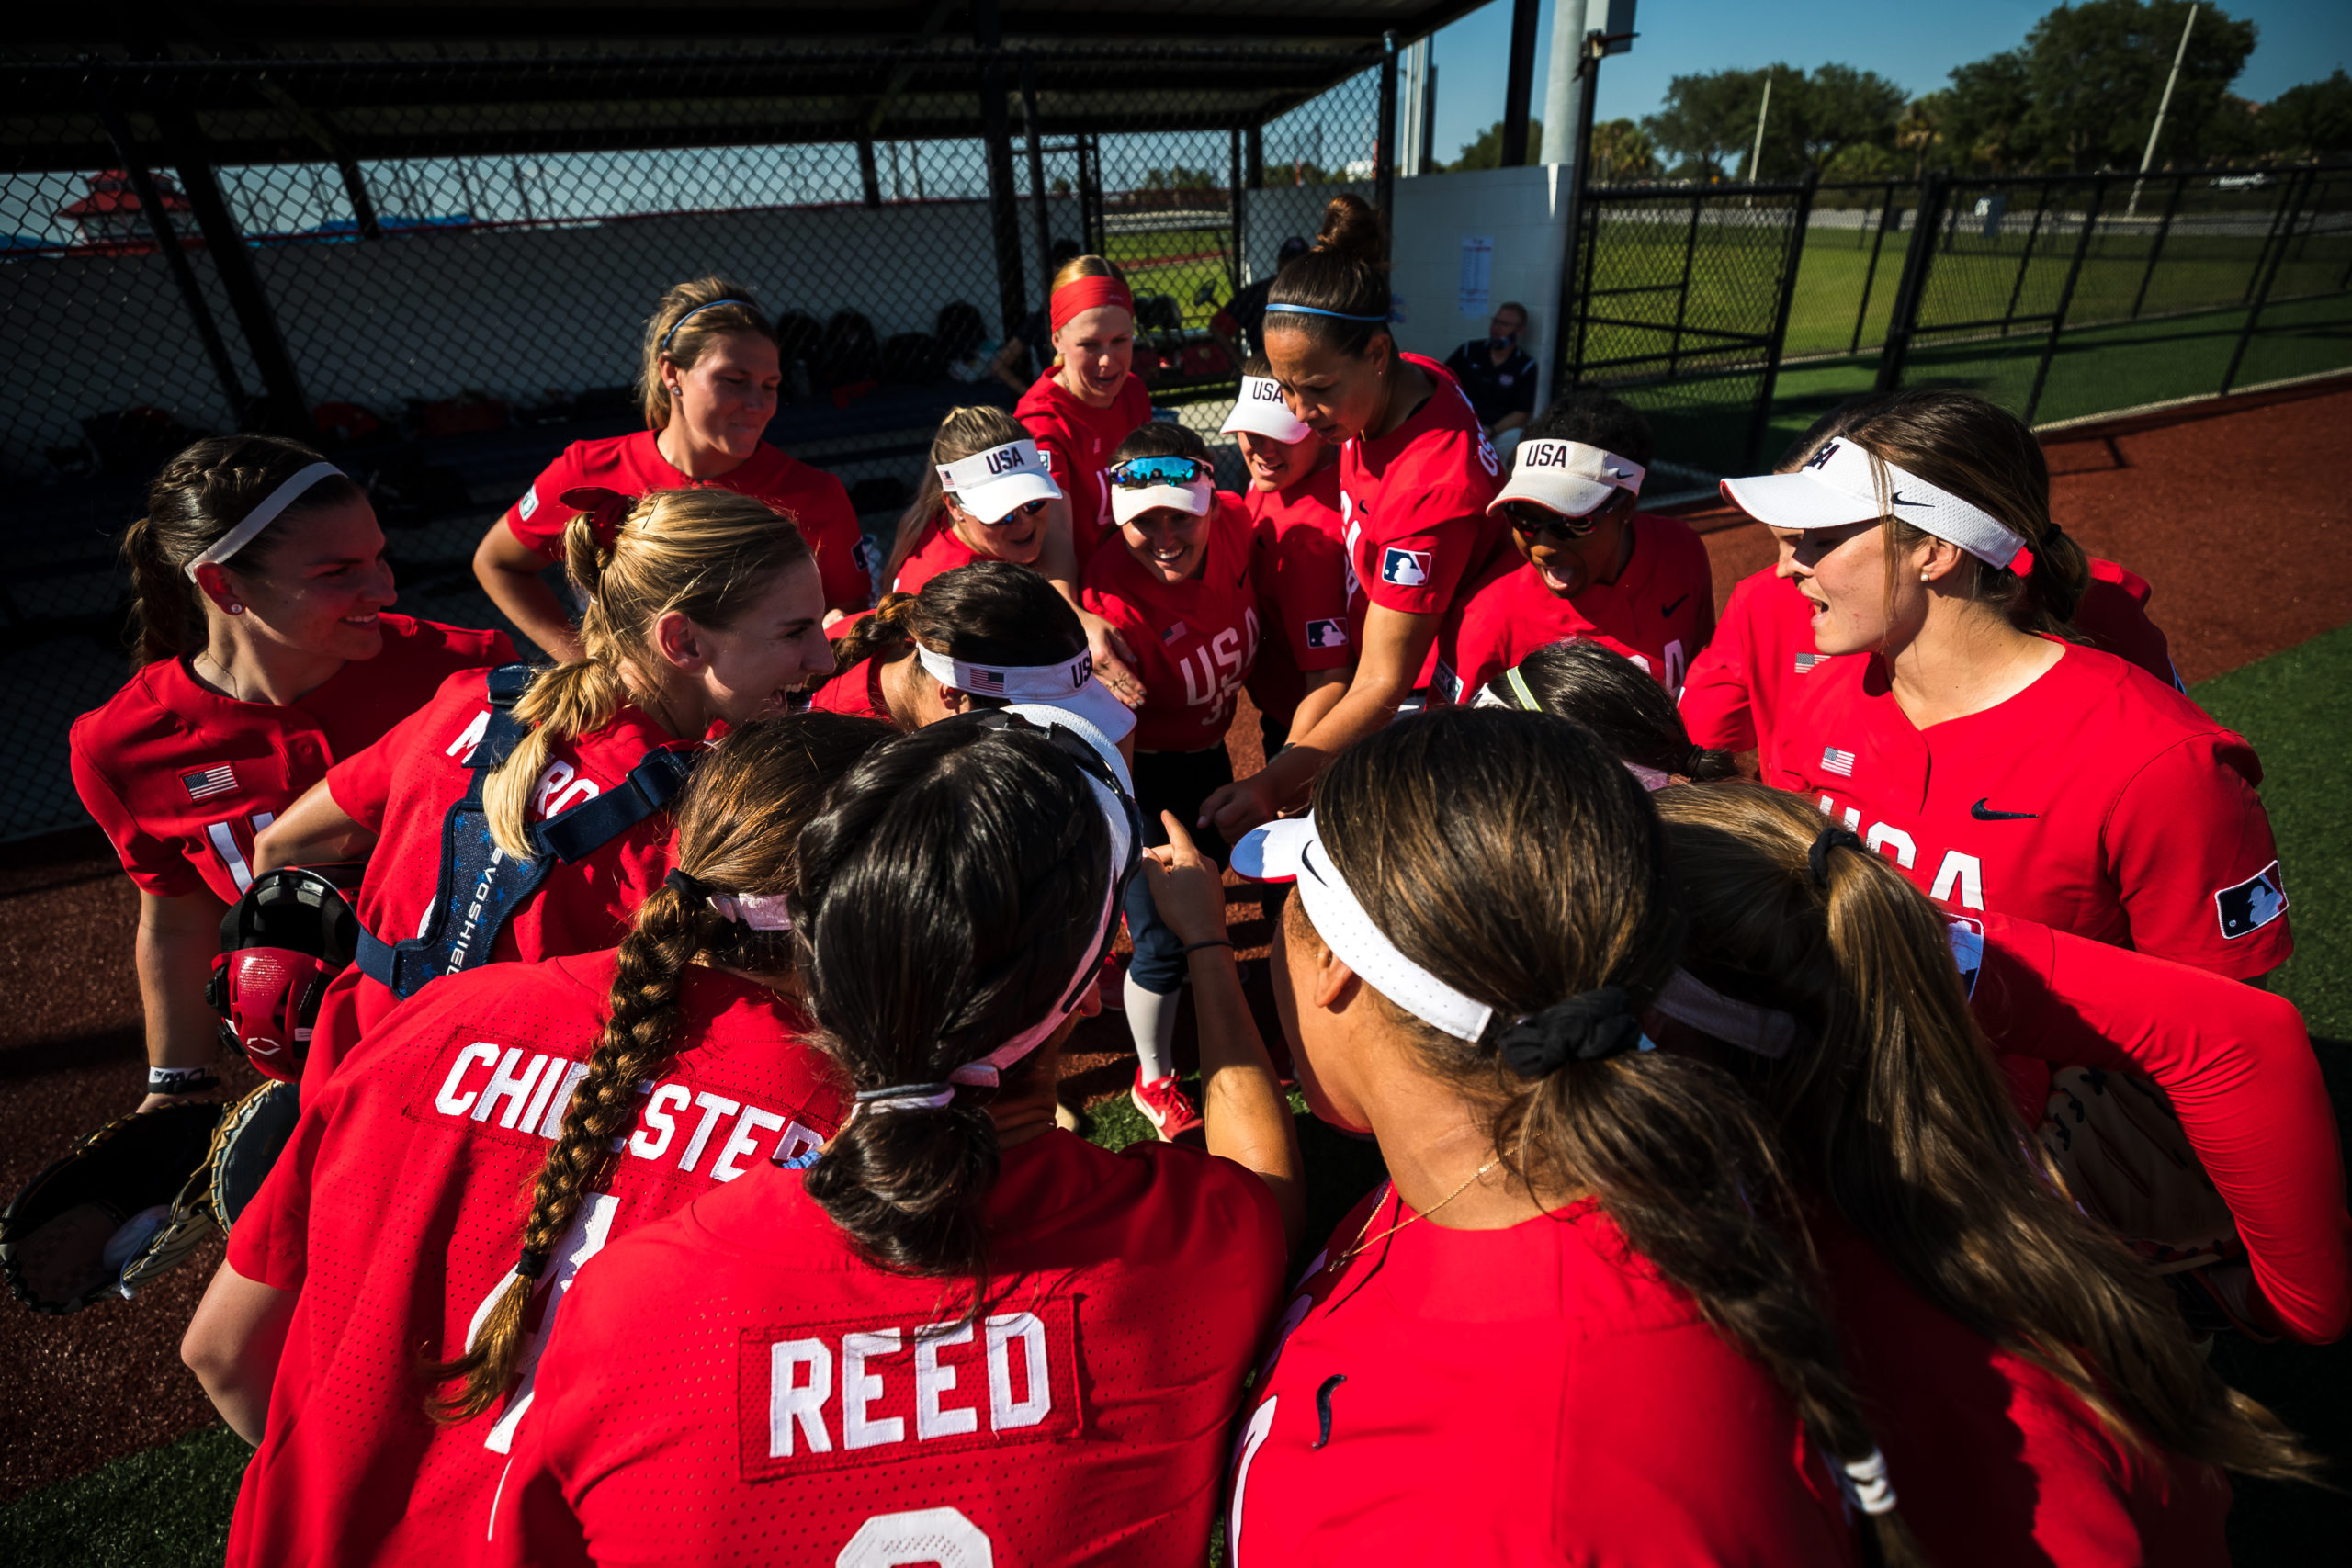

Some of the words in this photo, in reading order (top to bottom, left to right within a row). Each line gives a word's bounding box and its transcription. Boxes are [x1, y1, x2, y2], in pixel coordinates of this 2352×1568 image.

[1252, 380, 1283, 404] USA
[986, 446, 1025, 475] USA
[1525, 444, 1567, 468] USA
[1180, 605, 1260, 706] USA
[446, 710, 599, 819] MRO
[446, 846, 503, 976] EVOSHIEL
[769, 1312, 1052, 1459] REED
